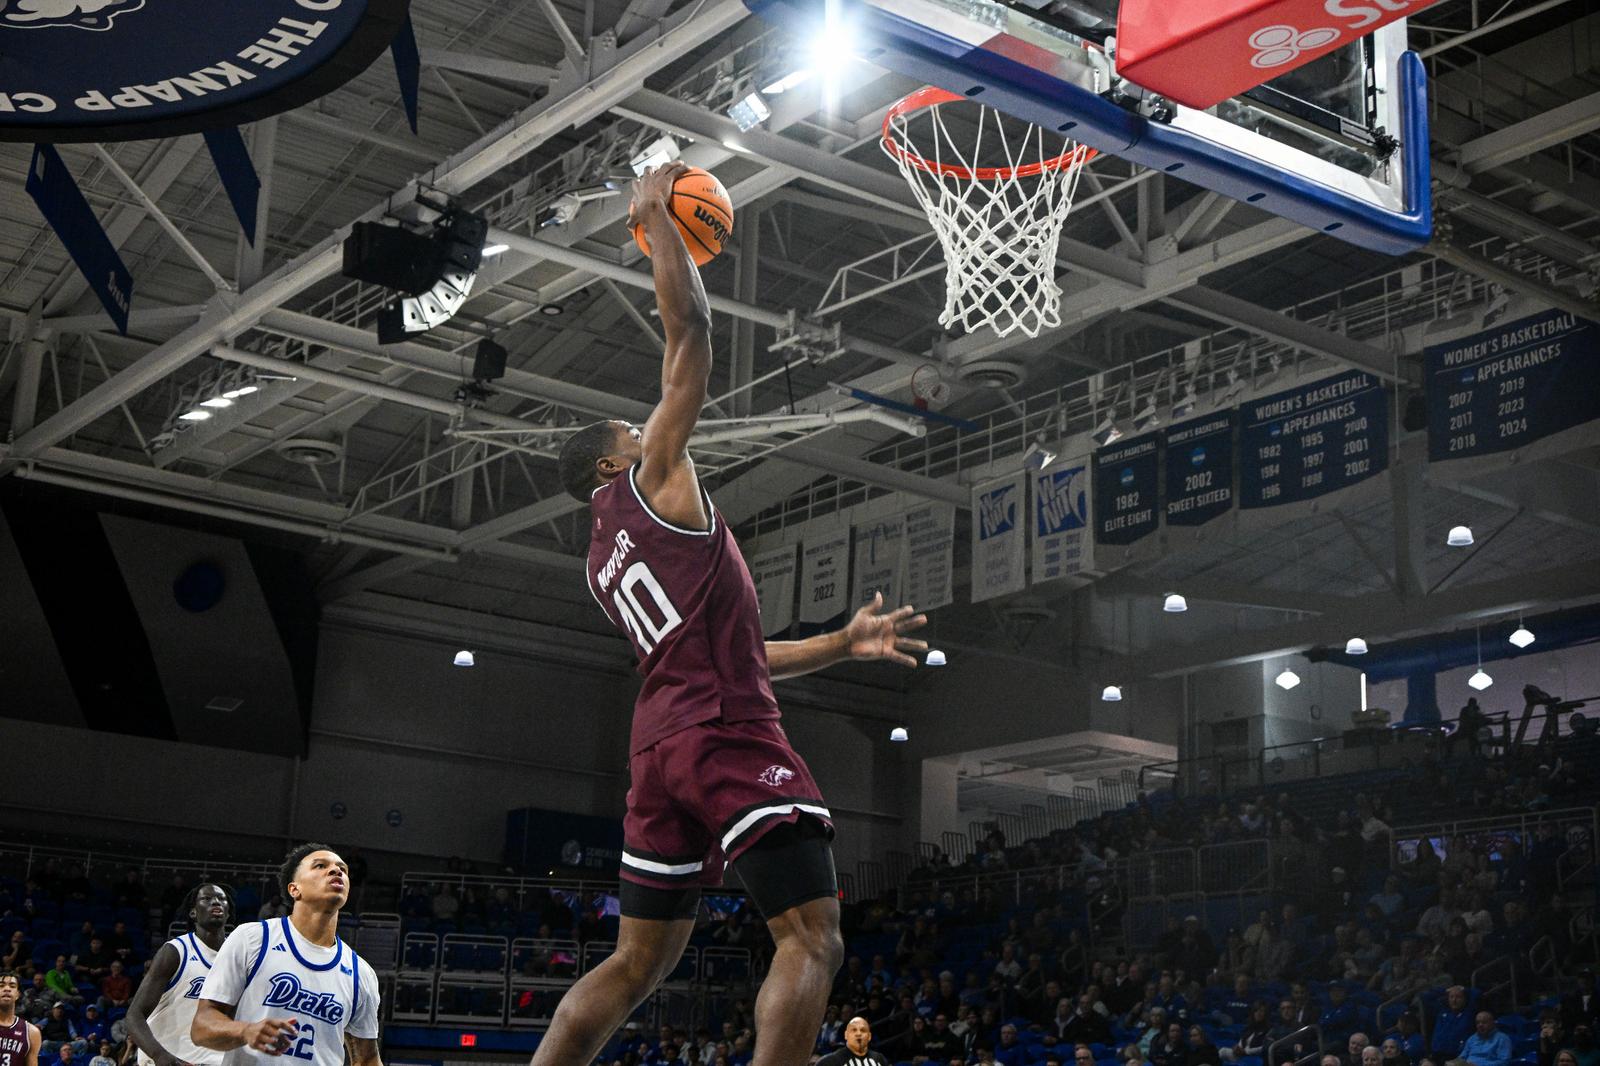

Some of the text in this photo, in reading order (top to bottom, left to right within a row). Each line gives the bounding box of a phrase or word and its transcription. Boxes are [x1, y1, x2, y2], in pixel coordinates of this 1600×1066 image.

[236, 17, 329, 69] THE
[74, 61, 257, 112] KNAPP
[1444, 339, 1498, 366] WOMEN'S
[1478, 343, 1561, 382] APPEARANCES
[1500, 376, 1525, 395] 2019
[1256, 374, 1369, 420] WOMEN'S BASKETBALL
[1499, 397, 1525, 416] 2023
[1283, 401, 1356, 435] APPEARANCES
[1450, 412, 1473, 430] 2017
[1500, 418, 1527, 437] 2024
[1301, 432, 1324, 448] 1995
[1344, 438, 1369, 455] 2001
[1450, 434, 1476, 451] 2018
[1259, 445, 1281, 459] 1982
[1303, 453, 1325, 468] 1997
[1345, 459, 1370, 476] 2002
[1185, 471, 1212, 491] 2002
[1116, 492, 1139, 511] 1982
[1167, 488, 1231, 514] SWEET SIXTEEN
[1105, 509, 1152, 532] ELITE EIGHT
[814, 582, 835, 602] 2022
[262, 972, 344, 1025] Drake
